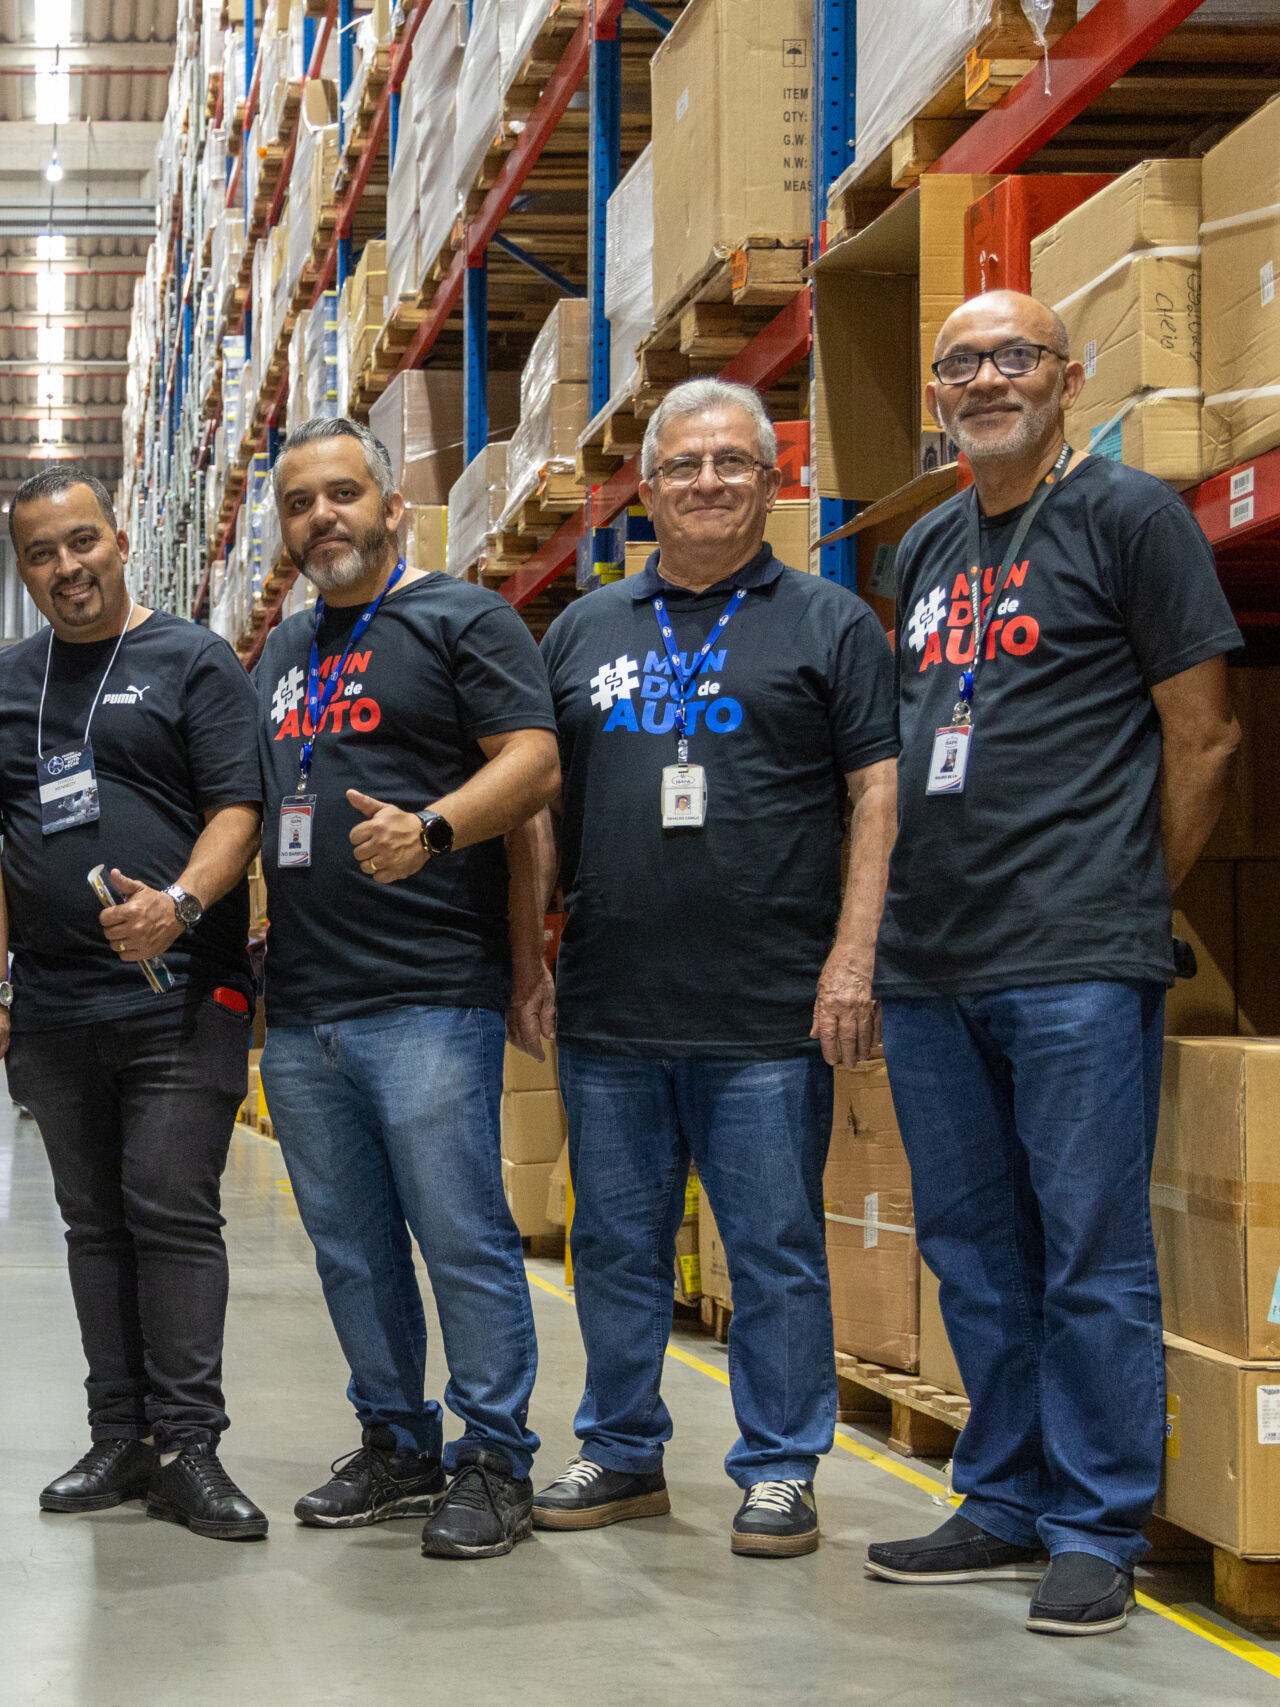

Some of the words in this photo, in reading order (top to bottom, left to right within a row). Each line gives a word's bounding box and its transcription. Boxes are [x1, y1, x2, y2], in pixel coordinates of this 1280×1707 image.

[783, 87, 808, 99] ITEM
[783, 111, 808, 123] QTY:
[783, 134, 808, 146] G.W:
[783, 157, 808, 169] N.W:
[997, 597, 1019, 615] de
[919, 615, 1040, 673] AUTO
[643, 649, 728, 676] MUN
[344, 681, 363, 696] de
[640, 675, 697, 701] DO
[698, 680, 720, 696] de
[102, 693, 137, 705] PUMA
[274, 697, 381, 741] AUTO
[602, 697, 743, 736] AUTO
